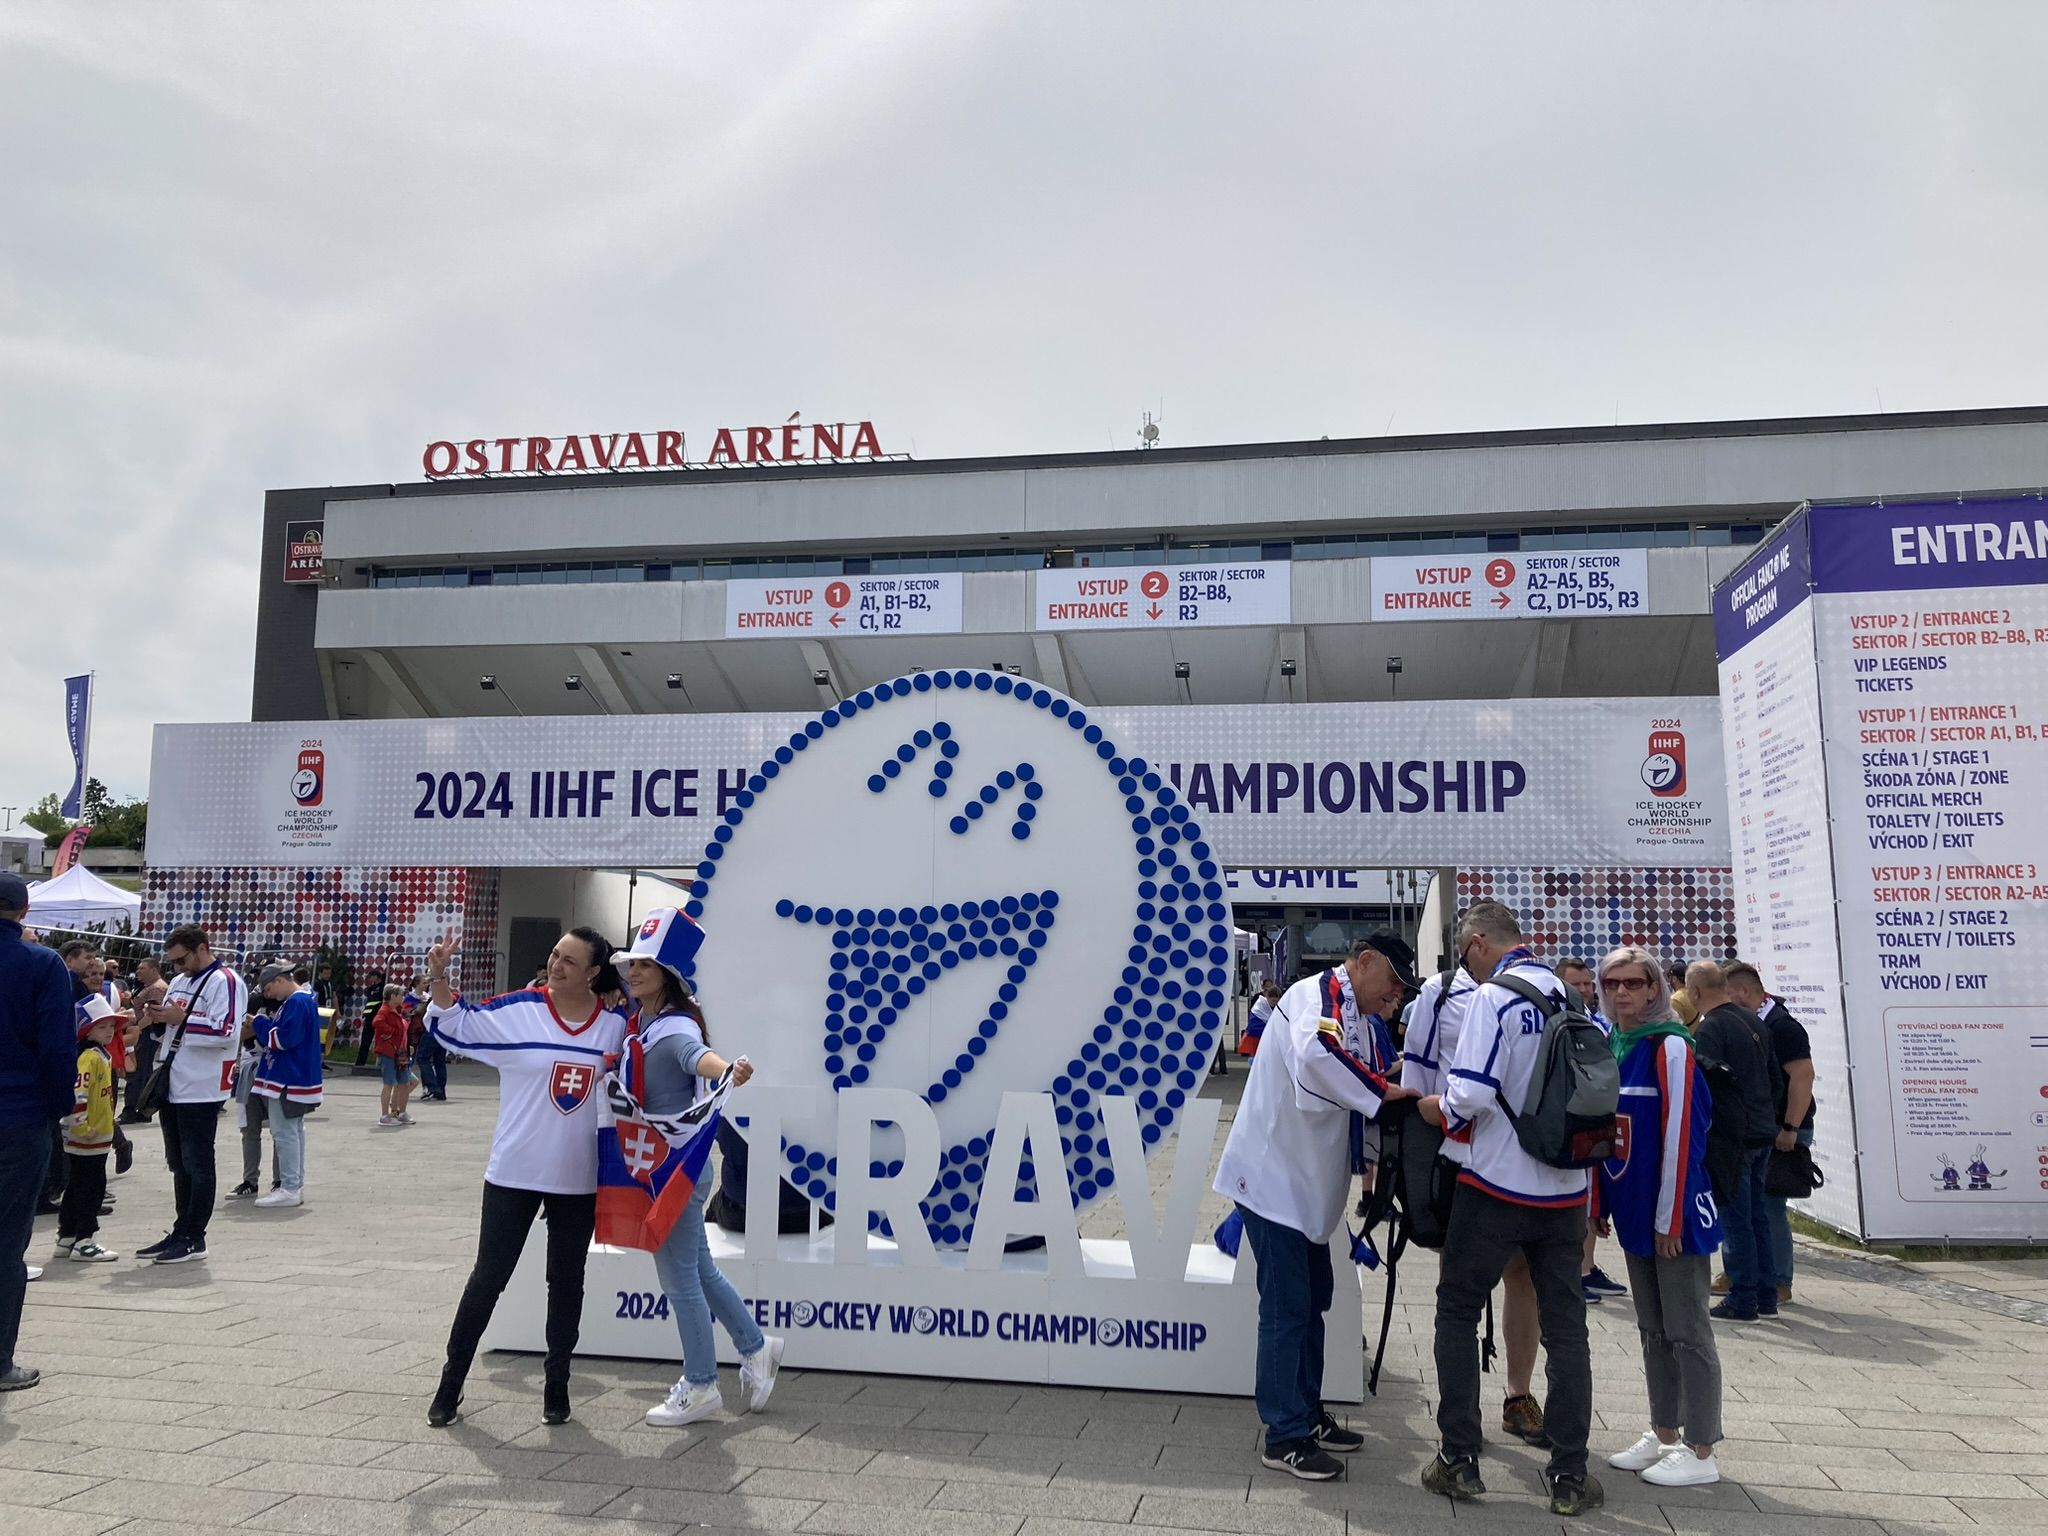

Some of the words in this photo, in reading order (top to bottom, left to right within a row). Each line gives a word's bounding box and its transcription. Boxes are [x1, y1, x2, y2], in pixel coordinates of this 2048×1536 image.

[422, 430, 684, 477] OSTRAVAR
[707, 411, 883, 464] ARÉNA
[290, 557, 323, 568] ARÉN
[1526, 558, 1568, 570] SEKTOR
[1579, 556, 1620, 568] SECTOR
[1179, 571, 1217, 581] SEKTOR
[1227, 569, 1265, 580] SECTOR
[1416, 567, 1471, 584] VSTUP
[1494, 566, 1506, 581] 3
[1588, 571, 1615, 590] B5,
[860, 582, 895, 591] SEKTOR
[904, 580, 939, 591] SECTOR
[1078, 580, 1128, 596] VSTUP
[1149, 578, 1160, 593] 2
[1731, 573, 1758, 611] OFFICIAL
[766, 589, 813, 605] VSTUP
[833, 588, 841, 602] 1
[860, 596, 880, 612] A1,
[1384, 591, 1471, 609] ENTRANCE
[1527, 593, 1551, 612] C2,
[1618, 591, 1639, 608] R3
[1049, 602, 1128, 619] ENTRANCE
[1179, 605, 1198, 620] R3
[1746, 586, 1778, 629] PROGRAM
[738, 611, 813, 628] ENTRANCE
[860, 614, 879, 631] C1,
[884, 613, 901, 629] R2
[1851, 615, 1897, 629] VSTUP
[1901, 614, 1909, 627] 2
[1923, 610, 1998, 626] ENTRANCE
[2003, 610, 2010, 623] 2
[1852, 634, 1907, 649] SEKTOR
[1922, 631, 1976, 647] SECTOR
[1854, 658, 1878, 672] VIP
[1882, 656, 1947, 672] LEGENDS
[1855, 678, 1913, 692] TICKETS
[1858, 709, 1906, 723] VSTUP
[1909, 708, 1916, 721] 1
[1930, 705, 2006, 721] ENTRANCE
[2010, 705, 2017, 718] 1
[1652, 719, 1681, 728] 2024
[1860, 729, 1916, 743] SEKTOR
[1931, 726, 1985, 742] SECTOR
[1991, 726, 2011, 742] A1,
[2015, 725, 2037, 741] B1,
[301, 740, 322, 748] 2024
[1654, 738, 1680, 748] IIHF
[301, 756, 321, 764] IIHF
[1862, 749, 1908, 767] SCÉNA
[1911, 752, 1918, 766] 1
[1933, 751, 1978, 765] STAGE
[1982, 750, 1989, 764] 1
[1864, 769, 1913, 788] ŠKODA
[1916, 768, 1956, 786] ZÓNA
[1970, 770, 2009, 785] ZONE
[414, 770, 514, 819] 2024
[529, 770, 615, 818] IIHF
[631, 769, 698, 817] ICE
[1171, 760, 1526, 814] AMPIONSHIP
[1636, 801, 1654, 809] ICE
[1657, 801, 1702, 809] HOCKEY
[1866, 793, 1927, 808] OFFICIAL
[1932, 792, 1982, 807] MERCH
[1627, 818, 1712, 826] CHAMPIONSHIP
[1867, 814, 1930, 829] TOALETY
[1944, 812, 2004, 827] TOILETS
[1636, 837, 1666, 846] Prague
[1869, 831, 1928, 849] VÝCHOD
[1943, 833, 1975, 848] EXIT
[1872, 866, 1920, 881] VSTUP
[1923, 866, 1932, 880] 3
[1947, 864, 2024, 880] ENTRANCE
[2028, 864, 2036, 878] 3
[1873, 887, 1931, 902] SEKTOR
[1945, 886, 2001, 901] SECTOR
[1875, 908, 1923, 926] SCÉNA
[1927, 912, 1935, 925] 2
[1949, 911, 1996, 925] STAGE
[2000, 910, 2008, 924] 2
[1877, 932, 1941, 947] TOALETY
[1955, 932, 2016, 946] TOILETS
[1879, 954, 1921, 968] TRAM
[1881, 971, 1941, 990] VÝCHOD
[1955, 975, 1988, 989] EXIT
[1897, 1022, 1938, 1030] OTEVÍRACÍ
[616, 1291, 670, 1320] 2024
[775, 1300, 882, 1332] HOCKEY
[889, 1305, 989, 1338] WORLD
[997, 1312, 1207, 1352] CHAMPIONSHIP
